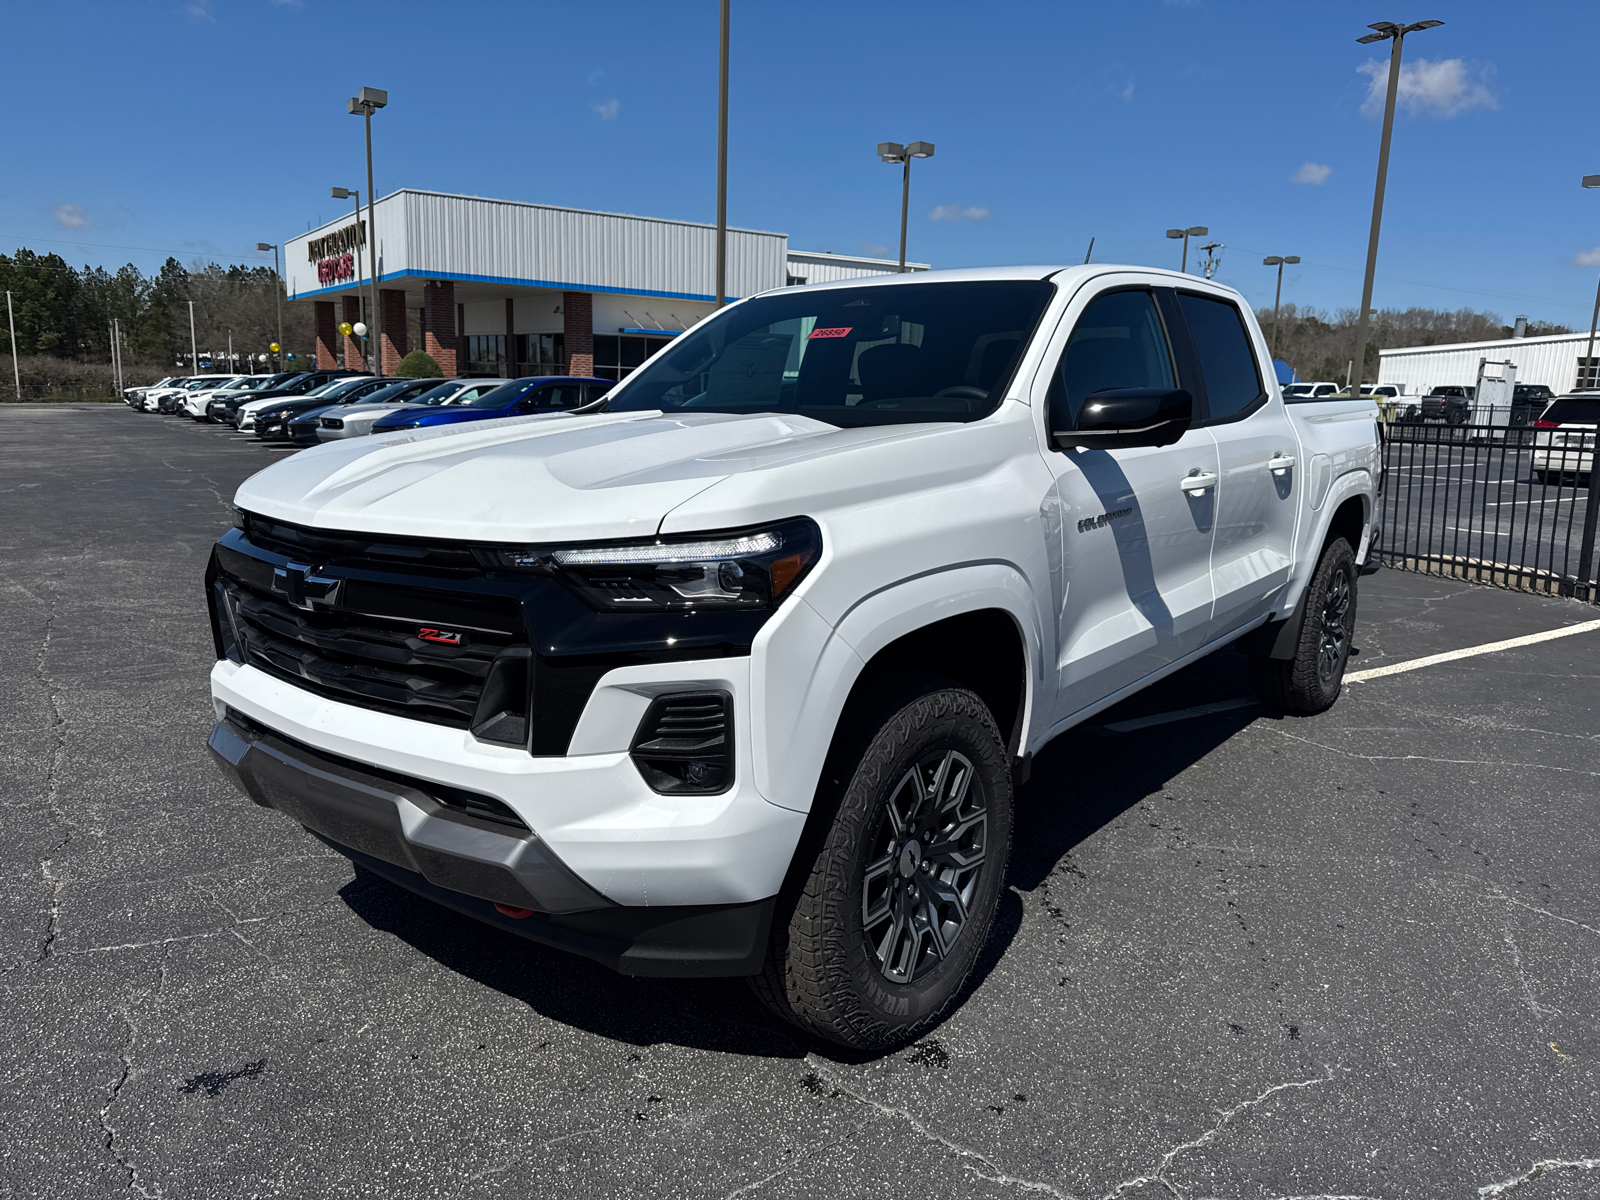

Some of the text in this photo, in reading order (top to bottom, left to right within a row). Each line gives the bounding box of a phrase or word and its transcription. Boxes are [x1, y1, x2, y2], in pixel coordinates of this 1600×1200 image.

[318, 253, 352, 283] USED CARS
[814, 328, 846, 337] 26850
[418, 627, 462, 644] Z71
